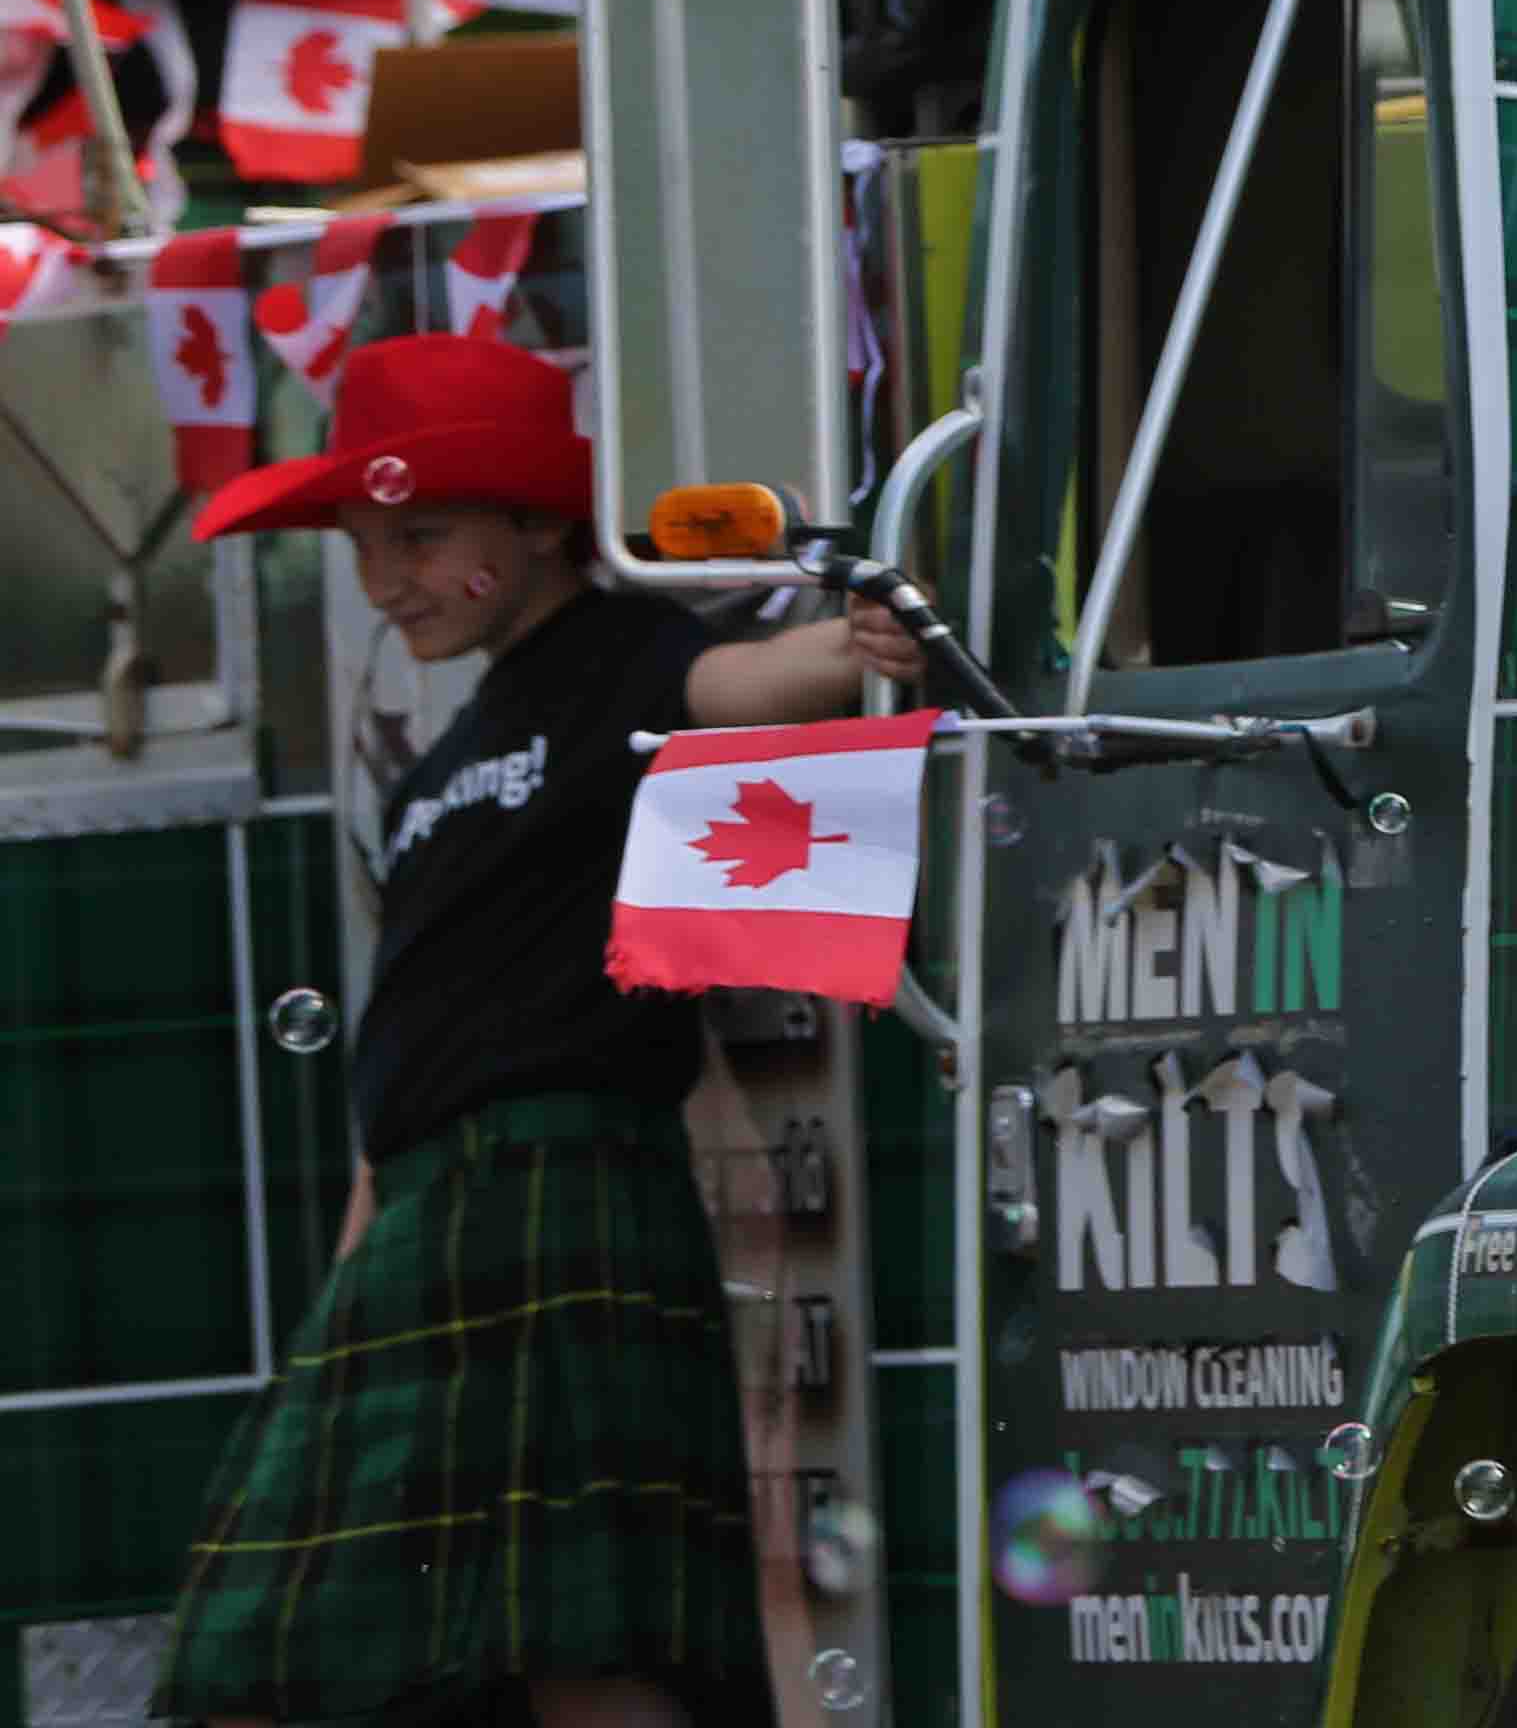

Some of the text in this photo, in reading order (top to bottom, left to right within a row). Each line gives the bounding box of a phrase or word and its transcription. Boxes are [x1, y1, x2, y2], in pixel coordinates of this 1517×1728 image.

[1057, 842, 1344, 1024] MEN IN
[1462, 1216, 1516, 1272] Free
[1061, 1341, 1345, 1410] WINDOW CLEANING
